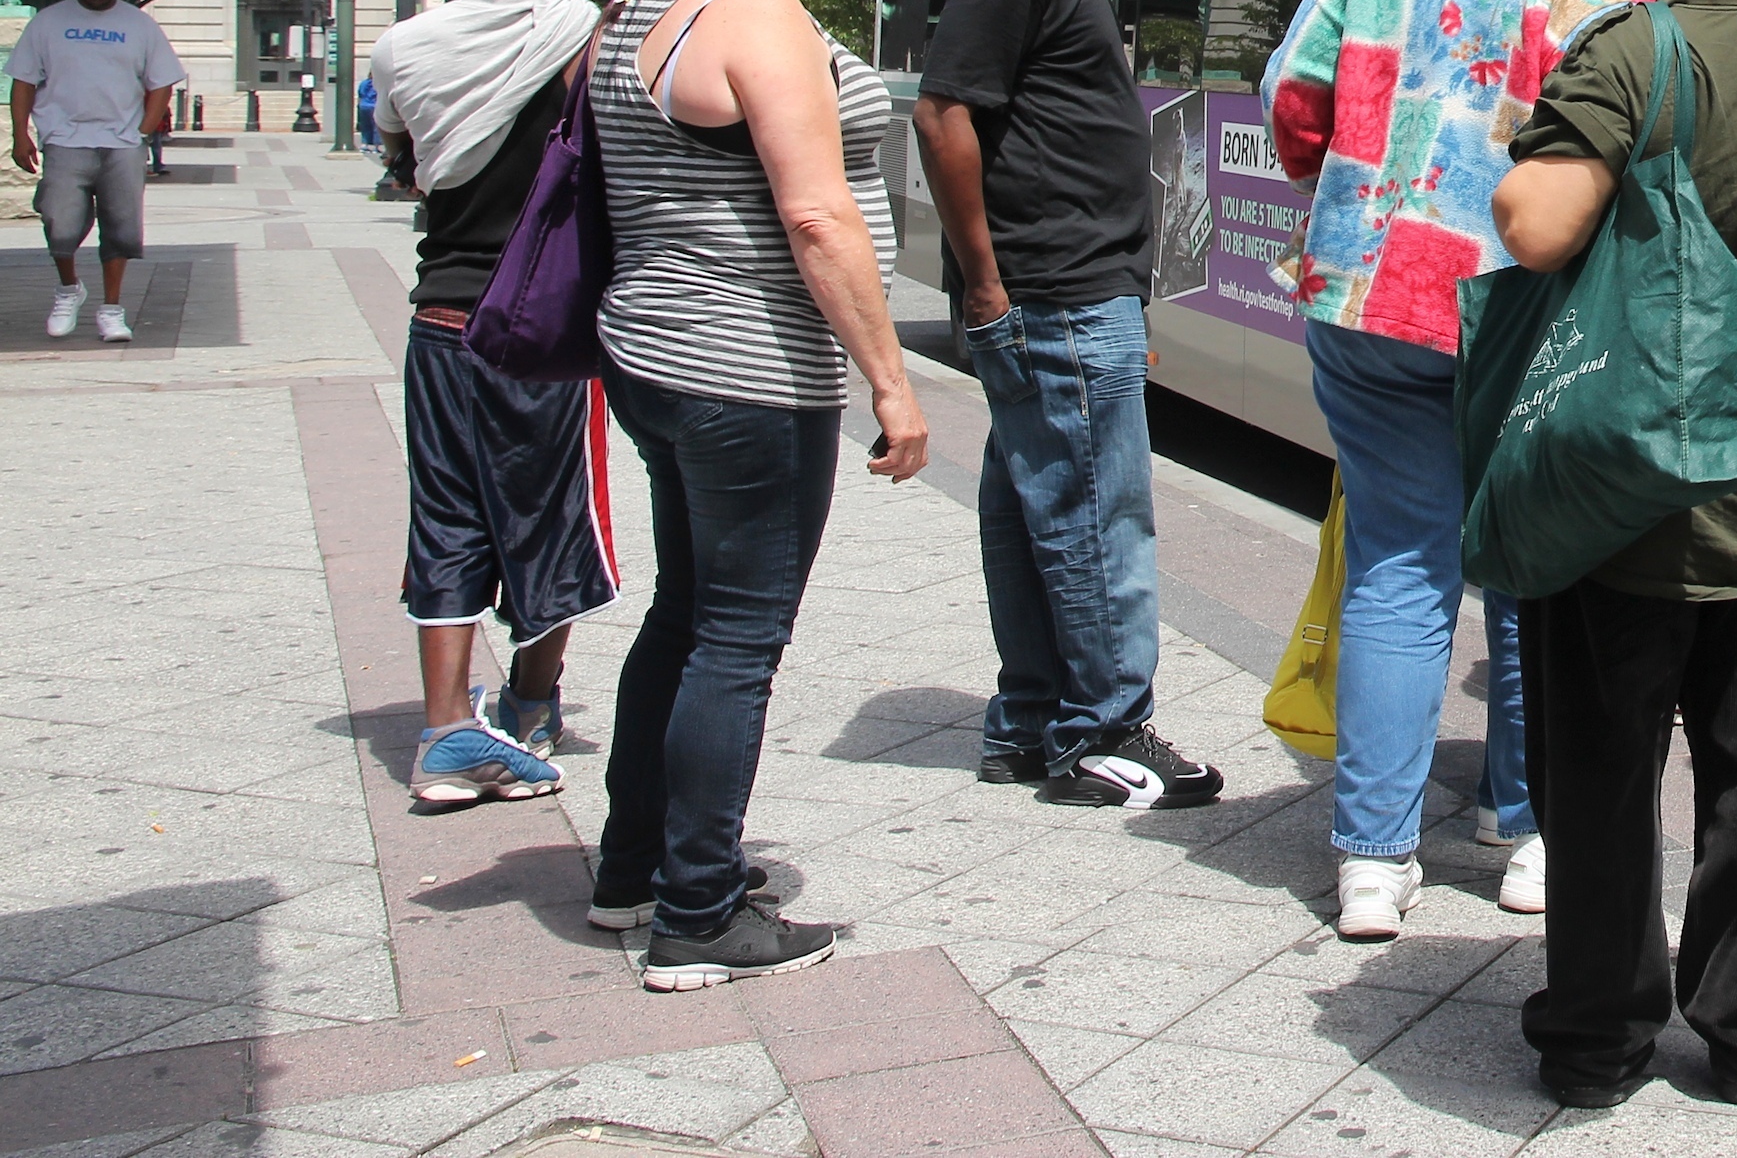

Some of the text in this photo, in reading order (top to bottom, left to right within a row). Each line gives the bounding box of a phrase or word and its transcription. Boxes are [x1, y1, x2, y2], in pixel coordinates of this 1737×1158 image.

[64, 28, 126, 43] CLAFLIN
[1223, 131, 1259, 168] BORN
[1221, 195, 1239, 221] YOU
[1240, 199, 1257, 225] ARE
[1258, 203, 1265, 227] 5
[1266, 204, 1293, 232] TIMES
[1220, 229, 1232, 253] TO
[1233, 232, 1244, 257] BE
